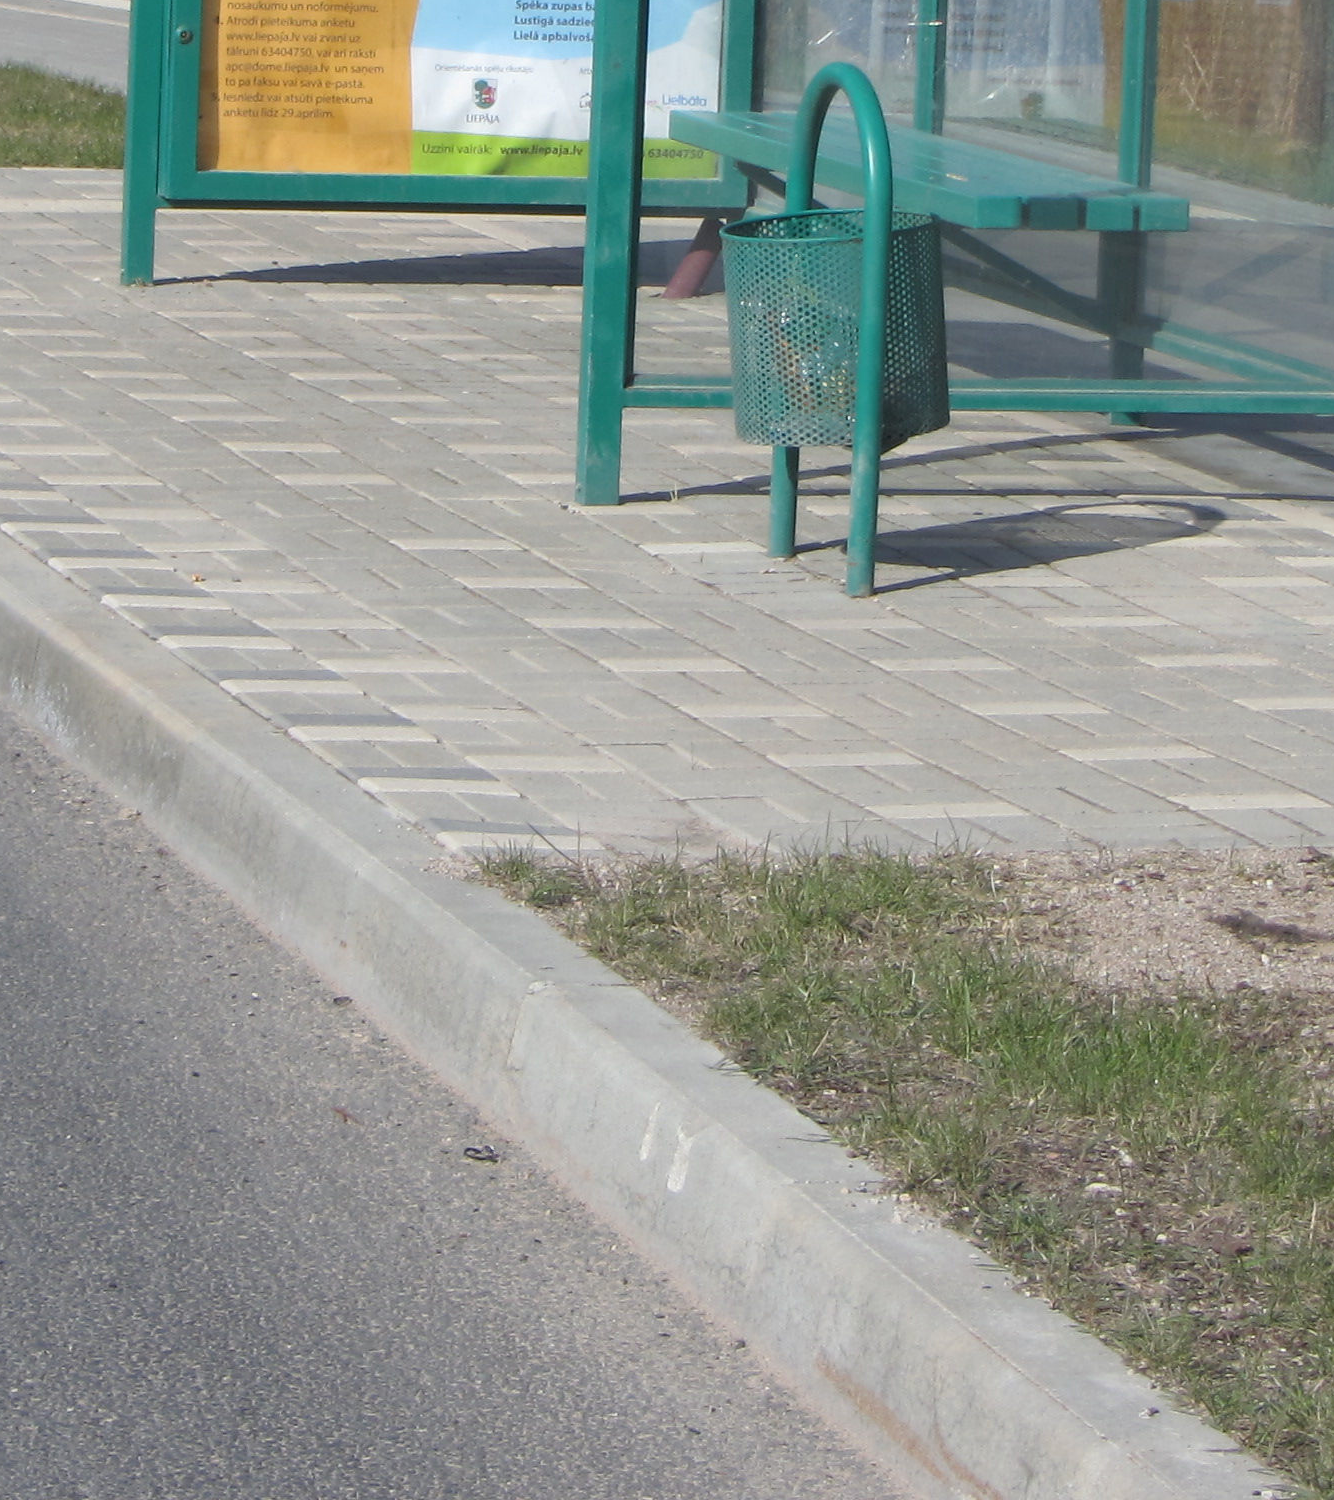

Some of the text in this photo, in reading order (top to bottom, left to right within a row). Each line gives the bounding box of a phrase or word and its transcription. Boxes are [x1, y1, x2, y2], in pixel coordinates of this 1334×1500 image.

[290, 3, 304, 12] un
[515, 0, 549, 12] Spēka
[551, 2, 583, 13] zupas
[334, 64, 348, 74] un
[499, 144, 584, 157] www.liepaja.lv
[648, 148, 705, 159] 63404750
